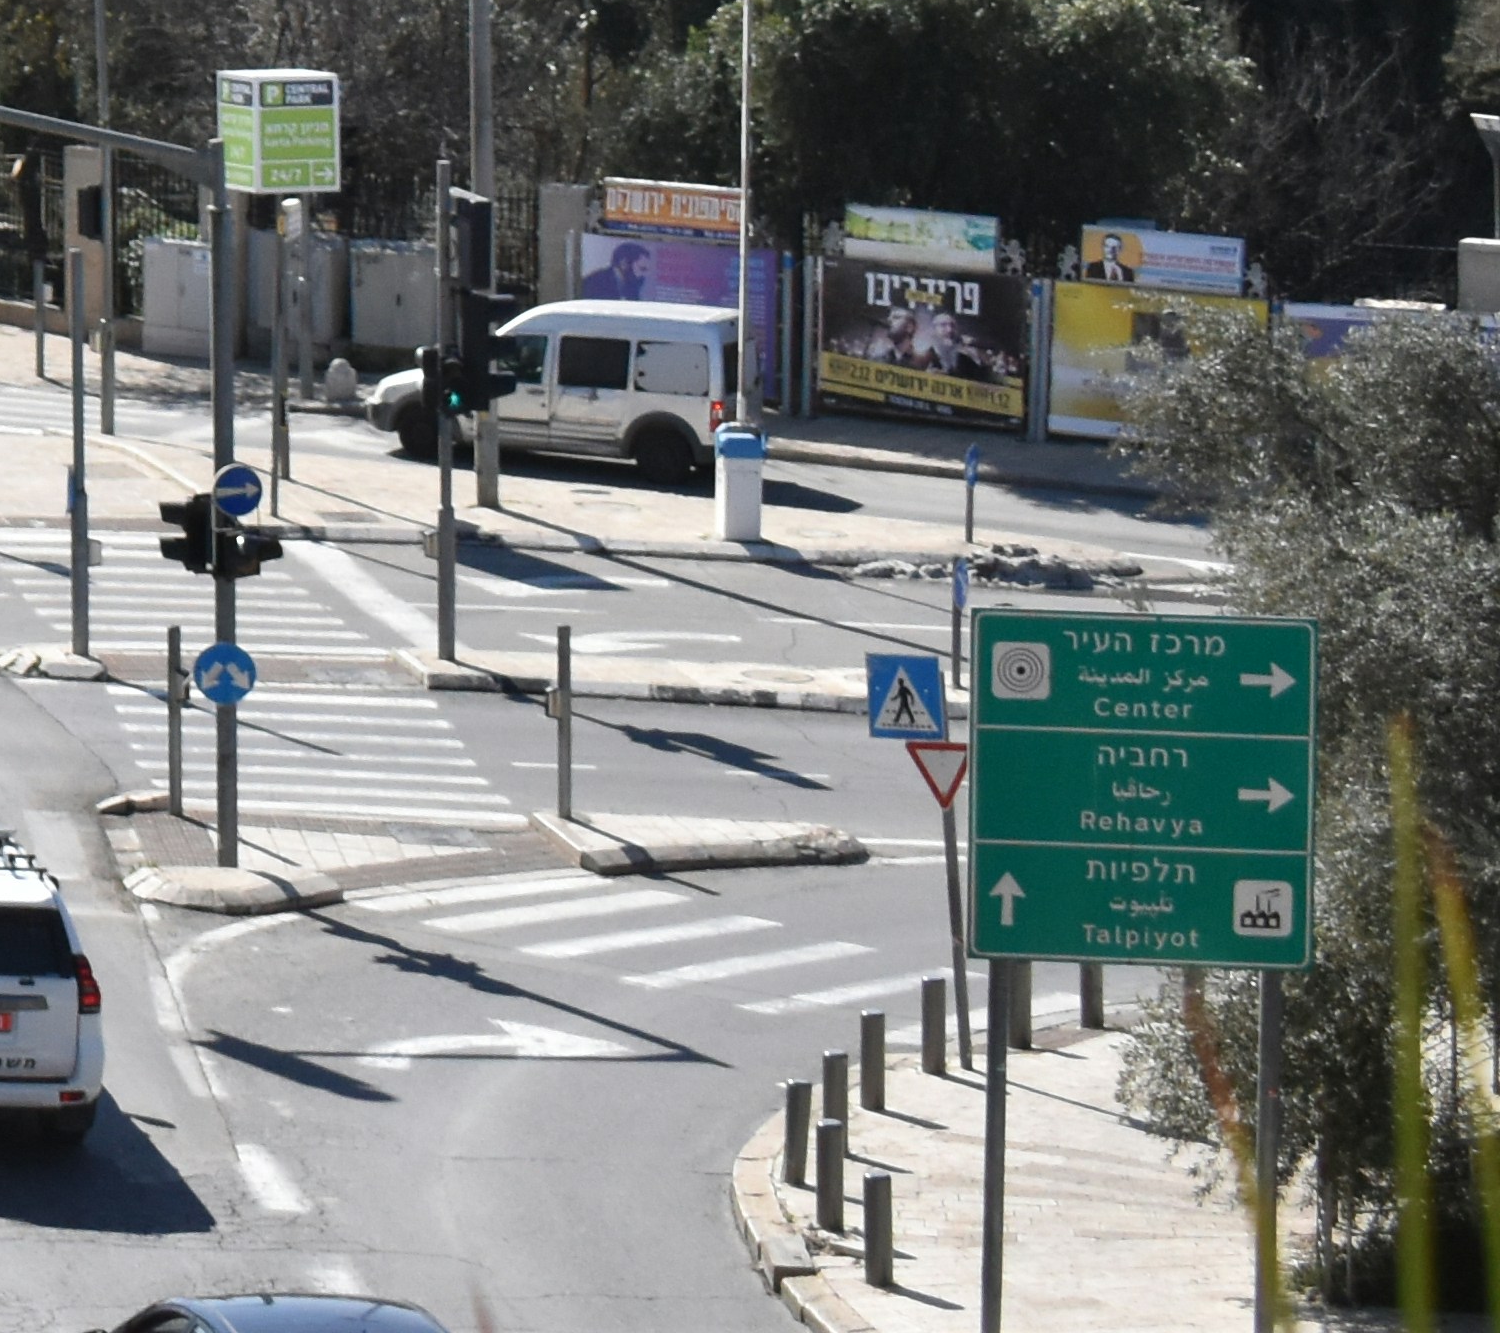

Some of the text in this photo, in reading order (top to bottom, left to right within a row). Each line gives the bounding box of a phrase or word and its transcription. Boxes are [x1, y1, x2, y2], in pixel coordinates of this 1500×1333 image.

[1062, 630, 1226, 656] מרכז העיר
[1162, 669, 1210, 693] مركز
[1093, 697, 1193, 719] Center
[1097, 745, 1188, 768] רחביה
[1080, 810, 1203, 838] Rehavya
[1085, 856, 1196, 884] תלפיות
[1082, 923, 1199, 950] Talpiyot
